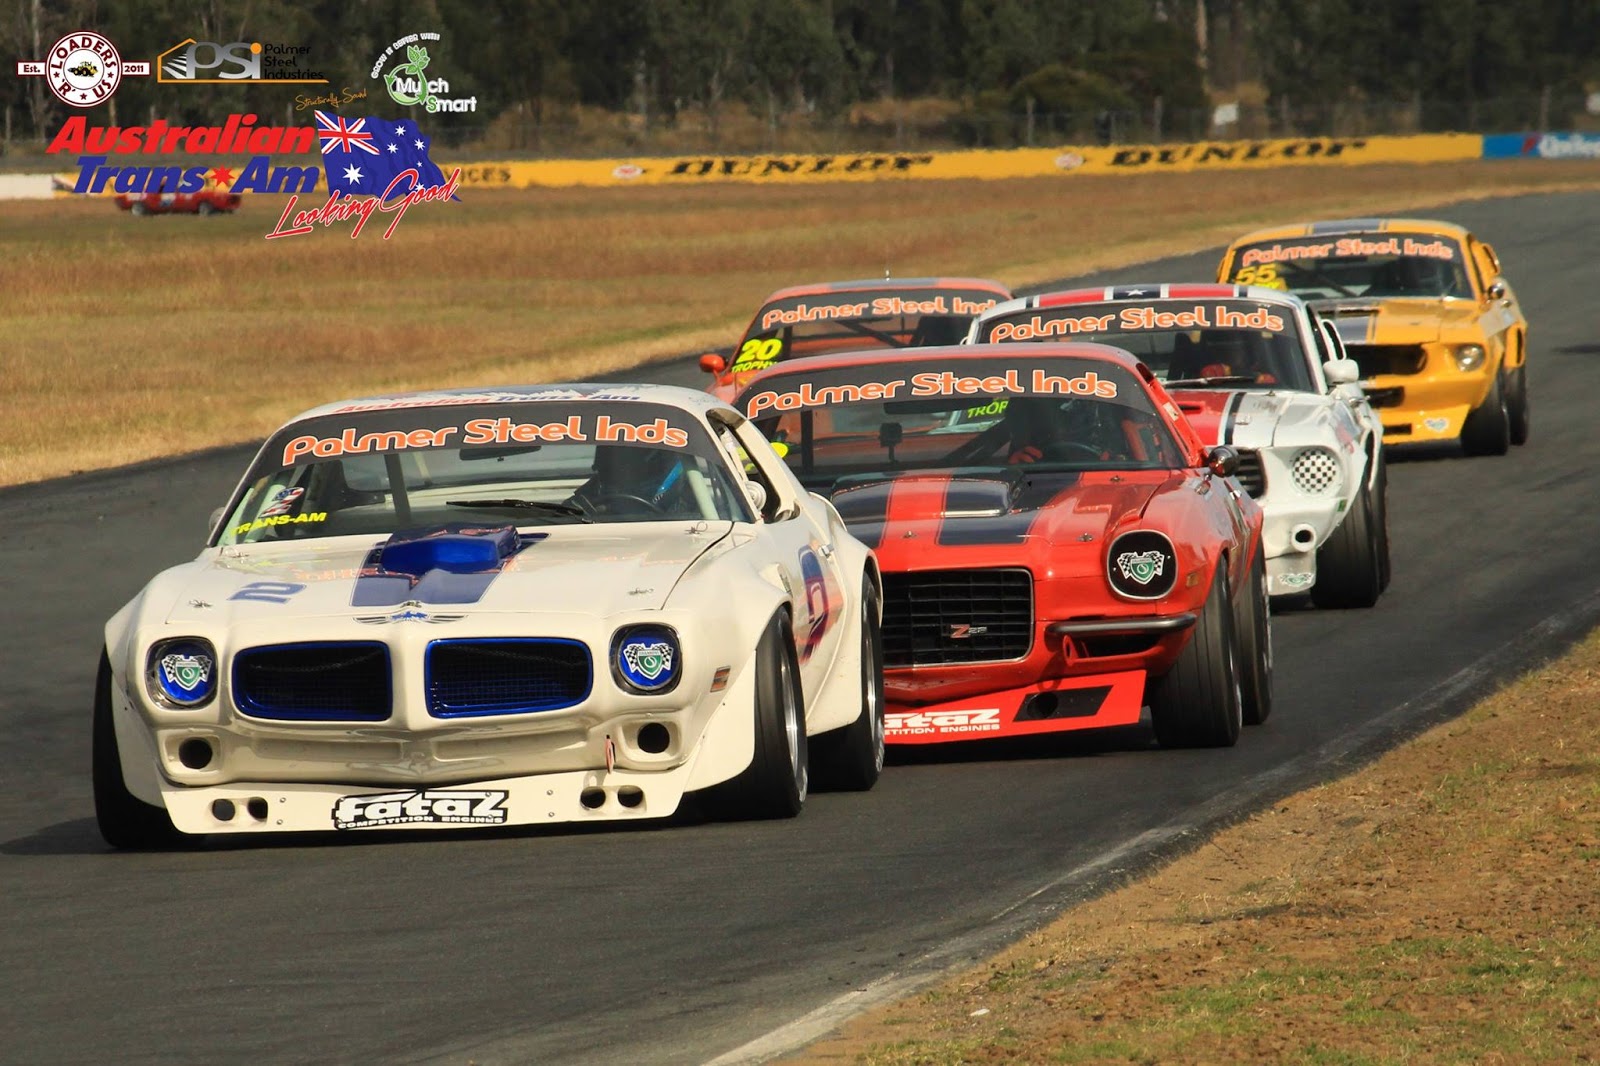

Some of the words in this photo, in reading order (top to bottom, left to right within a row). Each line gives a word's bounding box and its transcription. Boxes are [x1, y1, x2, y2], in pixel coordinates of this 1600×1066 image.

[665, 154, 934, 177] DUNLOP
[1105, 139, 1367, 166] DUNLOP
[1242, 243, 1334, 267] Palmer
[1335, 238, 1402, 258] Steel
[1403, 238, 1454, 260] Inds
[1234, 263, 1277, 286] 55
[762, 302, 869, 330] Palmer
[871, 296, 948, 315] Steel
[952, 297, 996, 315] Ind
[989, 314, 1114, 344] Palmer
[1119, 306, 1211, 329] Steel
[1216, 305, 1285, 333] Inds
[735, 338, 783, 364] 20
[746, 379, 906, 419] Palmer
[910, 369, 1025, 397] Steel
[1031, 369, 1118, 399] Inds
[967, 400, 1009, 419] TROP
[281, 426, 458, 466] Palmer
[462, 415, 588, 445] Steel
[594, 413, 689, 448] Inds
[230, 512, 328, 537] TRANS-AM
[940, 723, 1001, 733] ENGINES
[337, 815, 434, 830] COMPETITION
[441, 815, 504, 824] ENGINES
